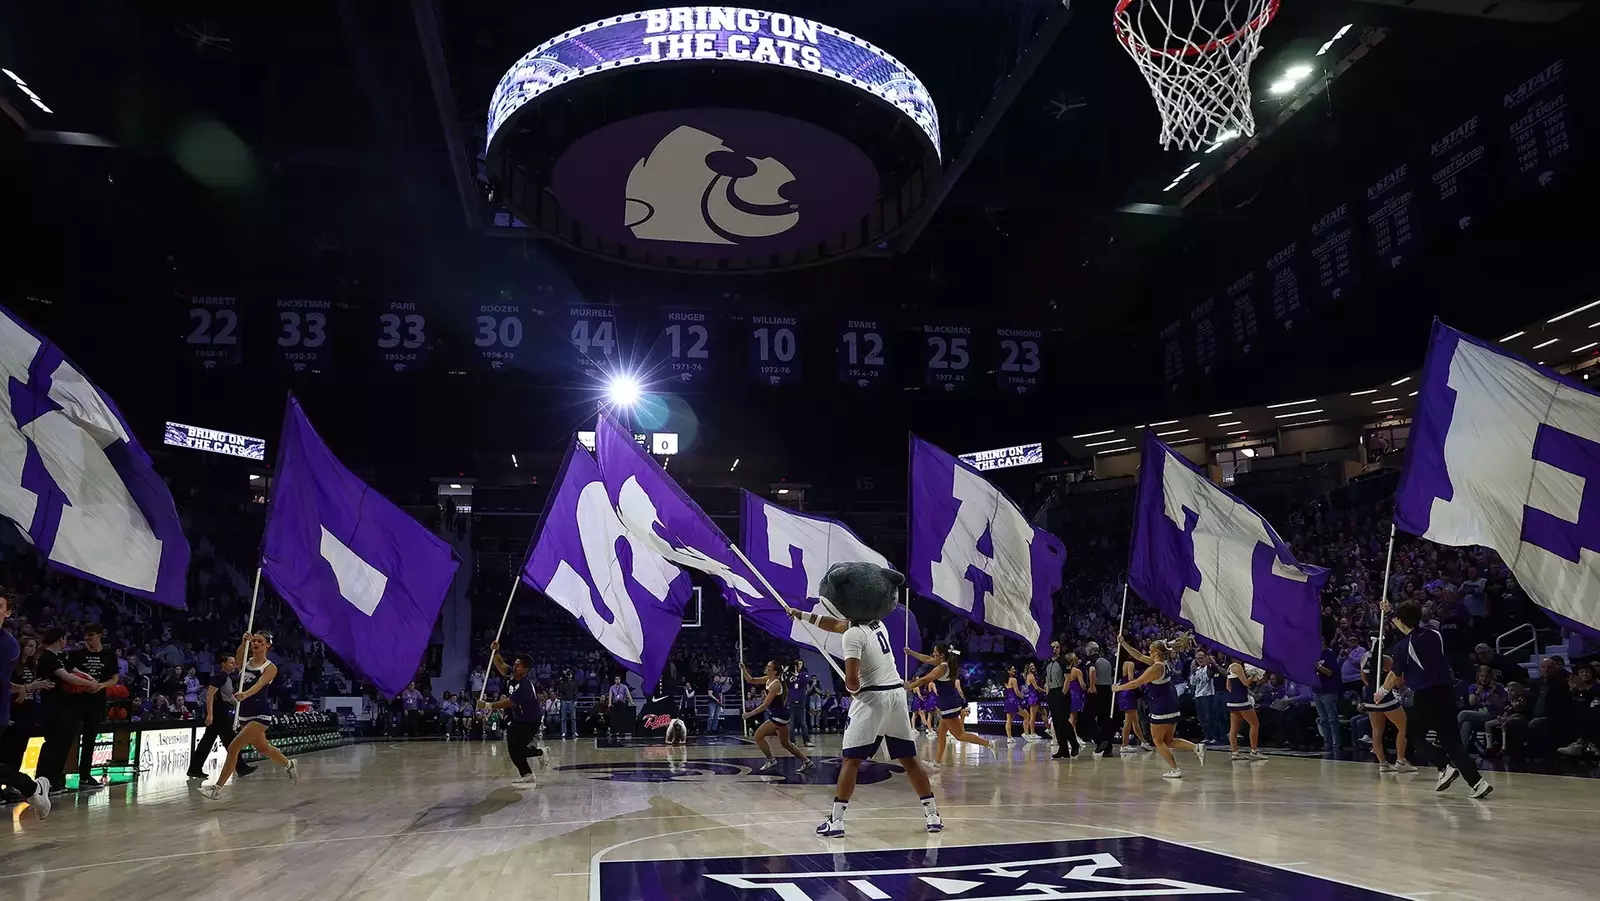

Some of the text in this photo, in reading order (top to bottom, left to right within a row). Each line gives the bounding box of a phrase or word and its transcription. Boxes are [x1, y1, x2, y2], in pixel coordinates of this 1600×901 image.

[645, 6, 819, 43] BRING ON
[642, 34, 824, 72] THE CATS
[1510, 94, 1564, 134] ELITE EIGHT
[191, 296, 237, 305] BARRETT
[277, 299, 331, 309] KNOSTMAN
[390, 302, 416, 311] PARR
[480, 305, 520, 313] BOOZER
[570, 308, 614, 317] MURRELL
[668, 312, 705, 321] KRUGER
[753, 315, 797, 325] WILLIAMS
[187, 308, 238, 344] 22
[277, 311, 326, 348] 33
[377, 313, 426, 348] 33
[474, 315, 523, 348] 30
[848, 320, 877, 329] EVANS
[924, 325, 971, 335] BLACKMAN
[996, 328, 1041, 338] RICHMOND
[571, 320, 615, 354] 44
[665, 324, 709, 358] 12
[753, 327, 796, 362] 10
[842, 331, 884, 365] 12
[927, 336, 969, 370] 25
[1000, 339, 1041, 373] 23
[760, 366, 791, 374] 1972-76
[187, 427, 246, 446] BRING ON
[661, 440, 669, 450] 0
[186, 437, 246, 456] THE CATS
[975, 446, 1024, 462] BRING ON
[975, 455, 1026, 470] THE CATS
[931, 464, 1040, 652] A
[1163, 450, 1308, 659] T
[545, 481, 681, 664] S
[157, 731, 189, 746] Ascension
